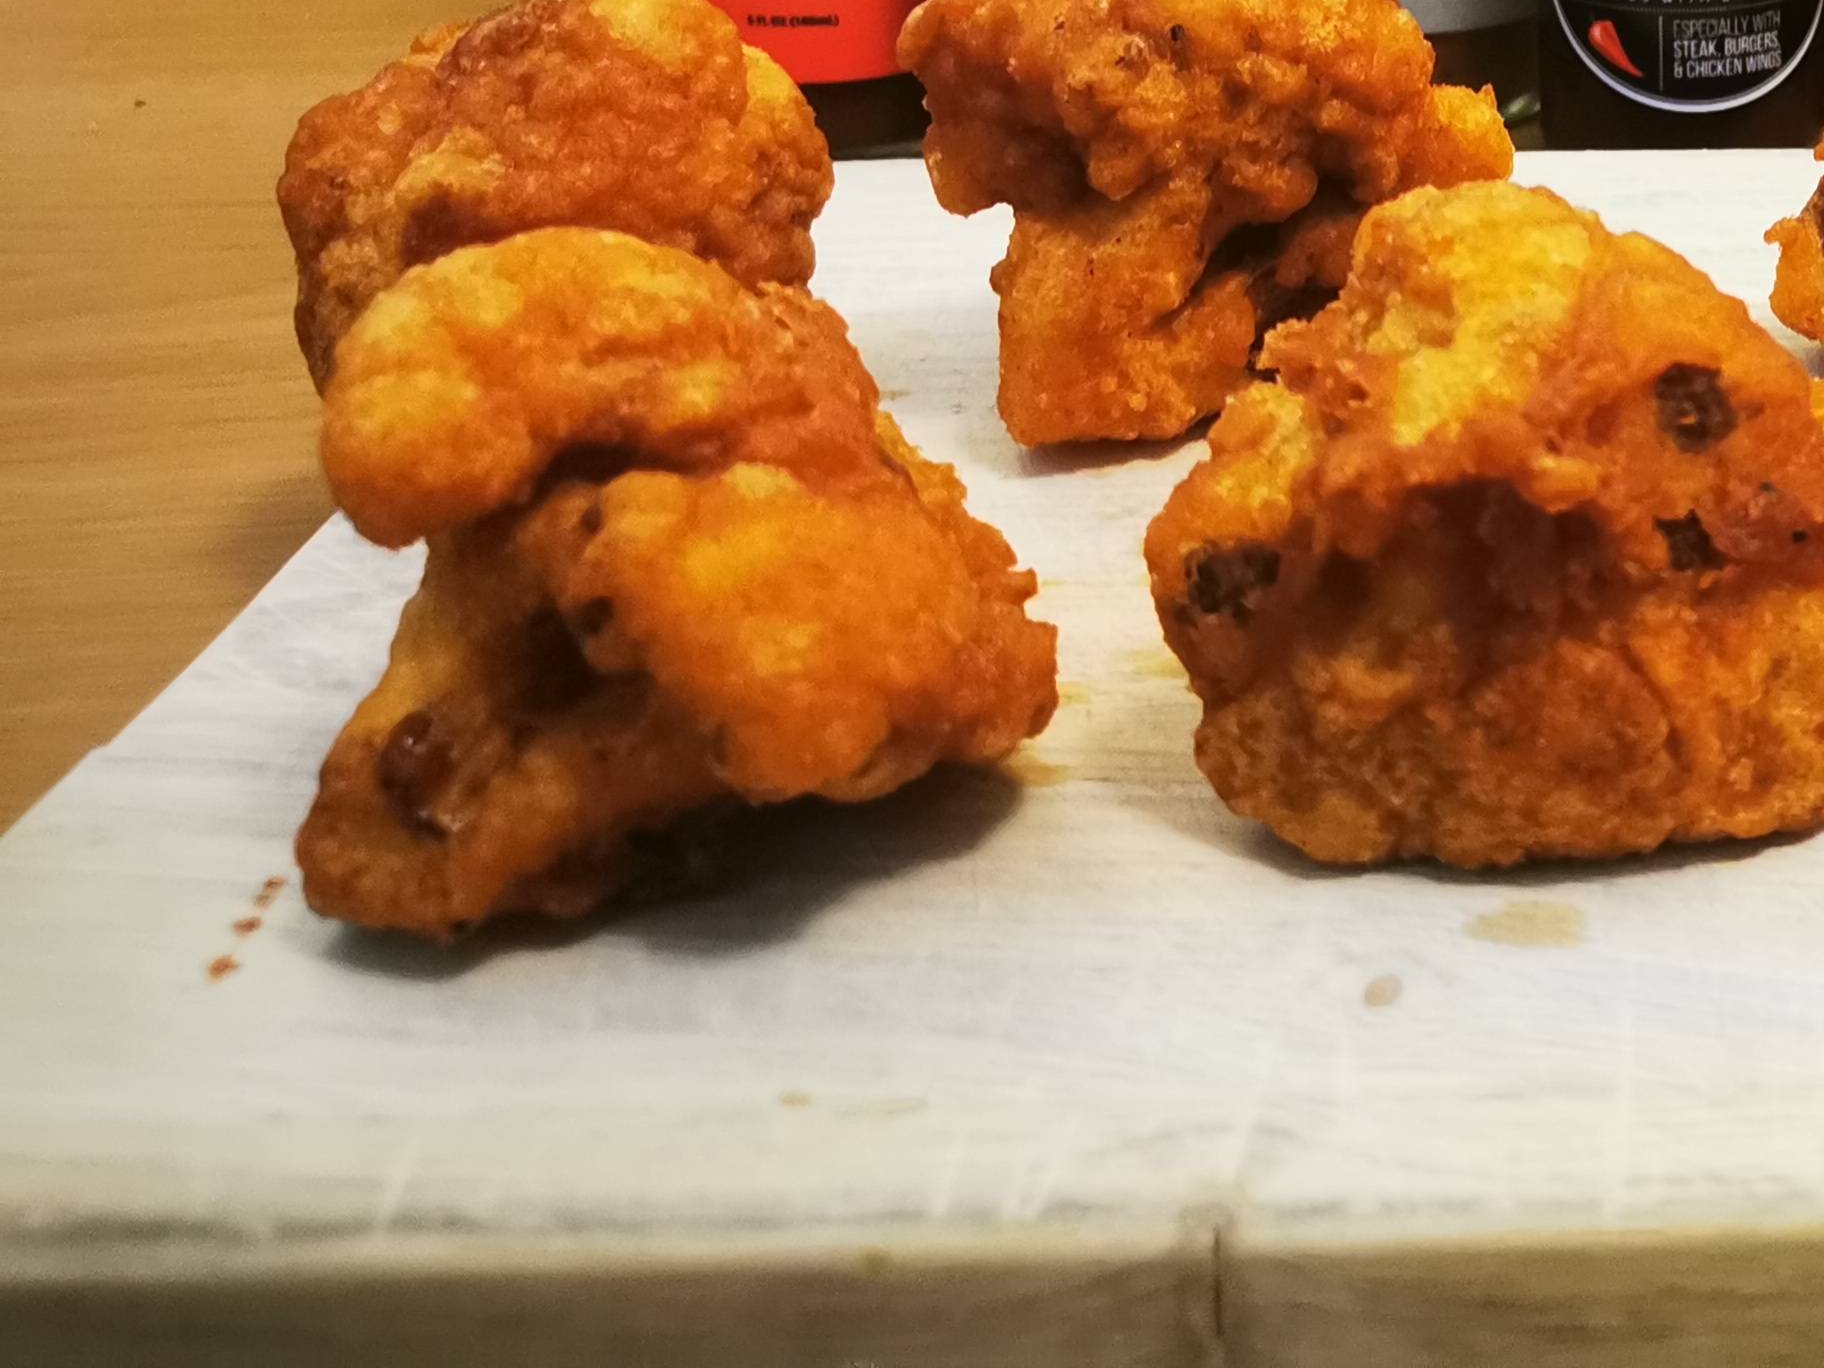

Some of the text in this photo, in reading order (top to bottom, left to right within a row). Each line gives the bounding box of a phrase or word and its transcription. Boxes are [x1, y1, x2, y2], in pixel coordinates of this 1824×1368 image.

[1672, 9, 1781, 39] ESPECIALLY WITH
[1673, 50, 1782, 79] & CHICKEN WINGS
